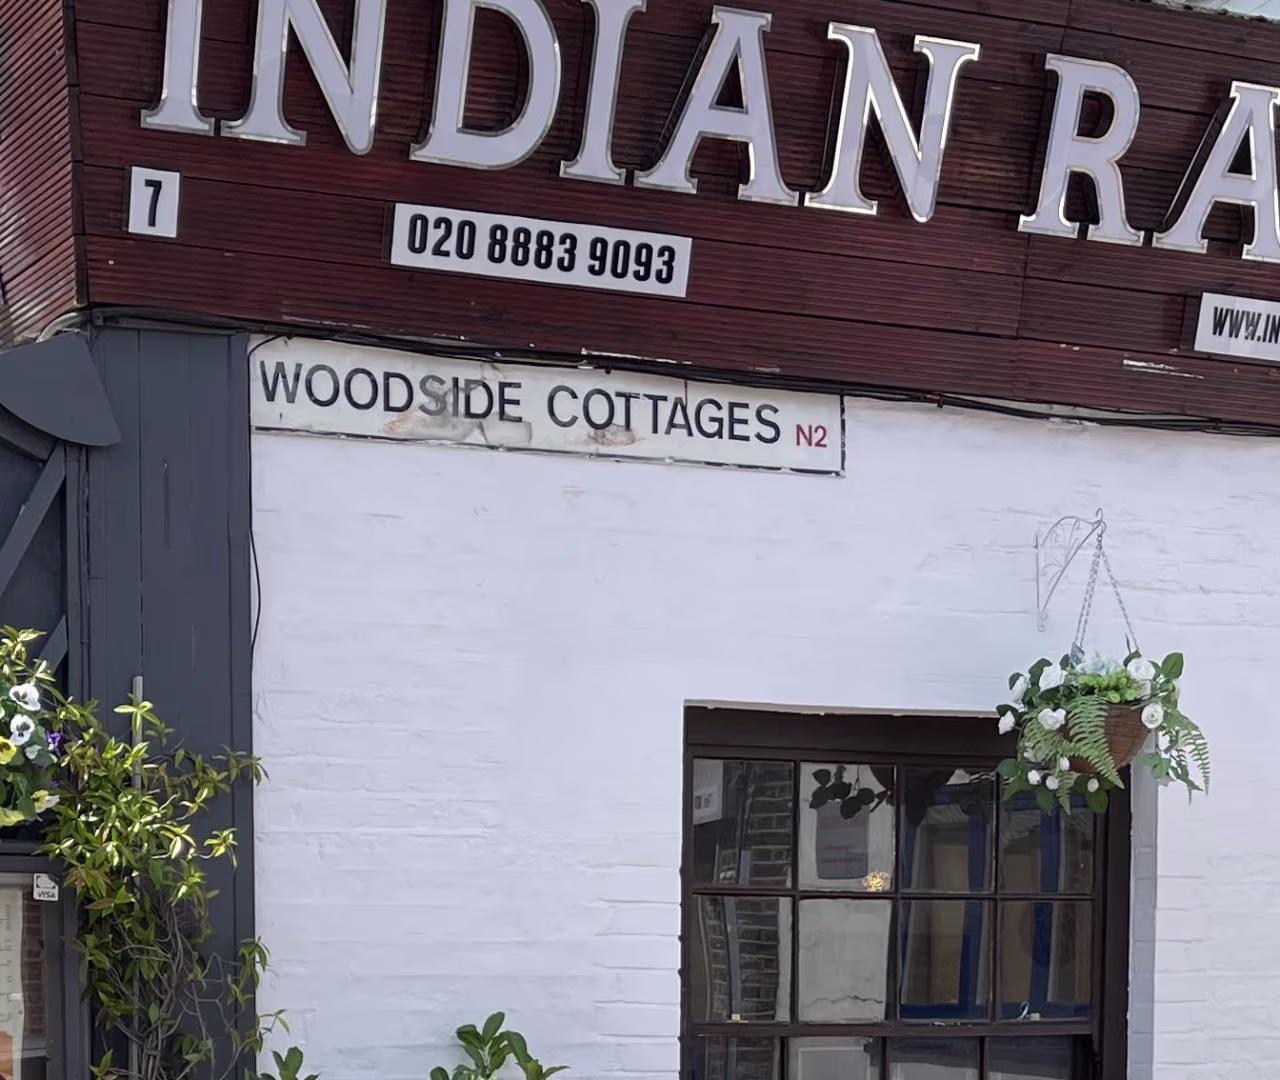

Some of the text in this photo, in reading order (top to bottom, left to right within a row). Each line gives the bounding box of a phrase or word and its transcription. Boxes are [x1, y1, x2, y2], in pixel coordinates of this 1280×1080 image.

[140, 0, 980, 222] INDIAN
[143, 179, 164, 228] 7
[407, 213, 676, 284] 020 8883 9093
[259, 360, 828, 448] WOODSIDE COTTAGES N2
[37, 889, 56, 899] VISA
